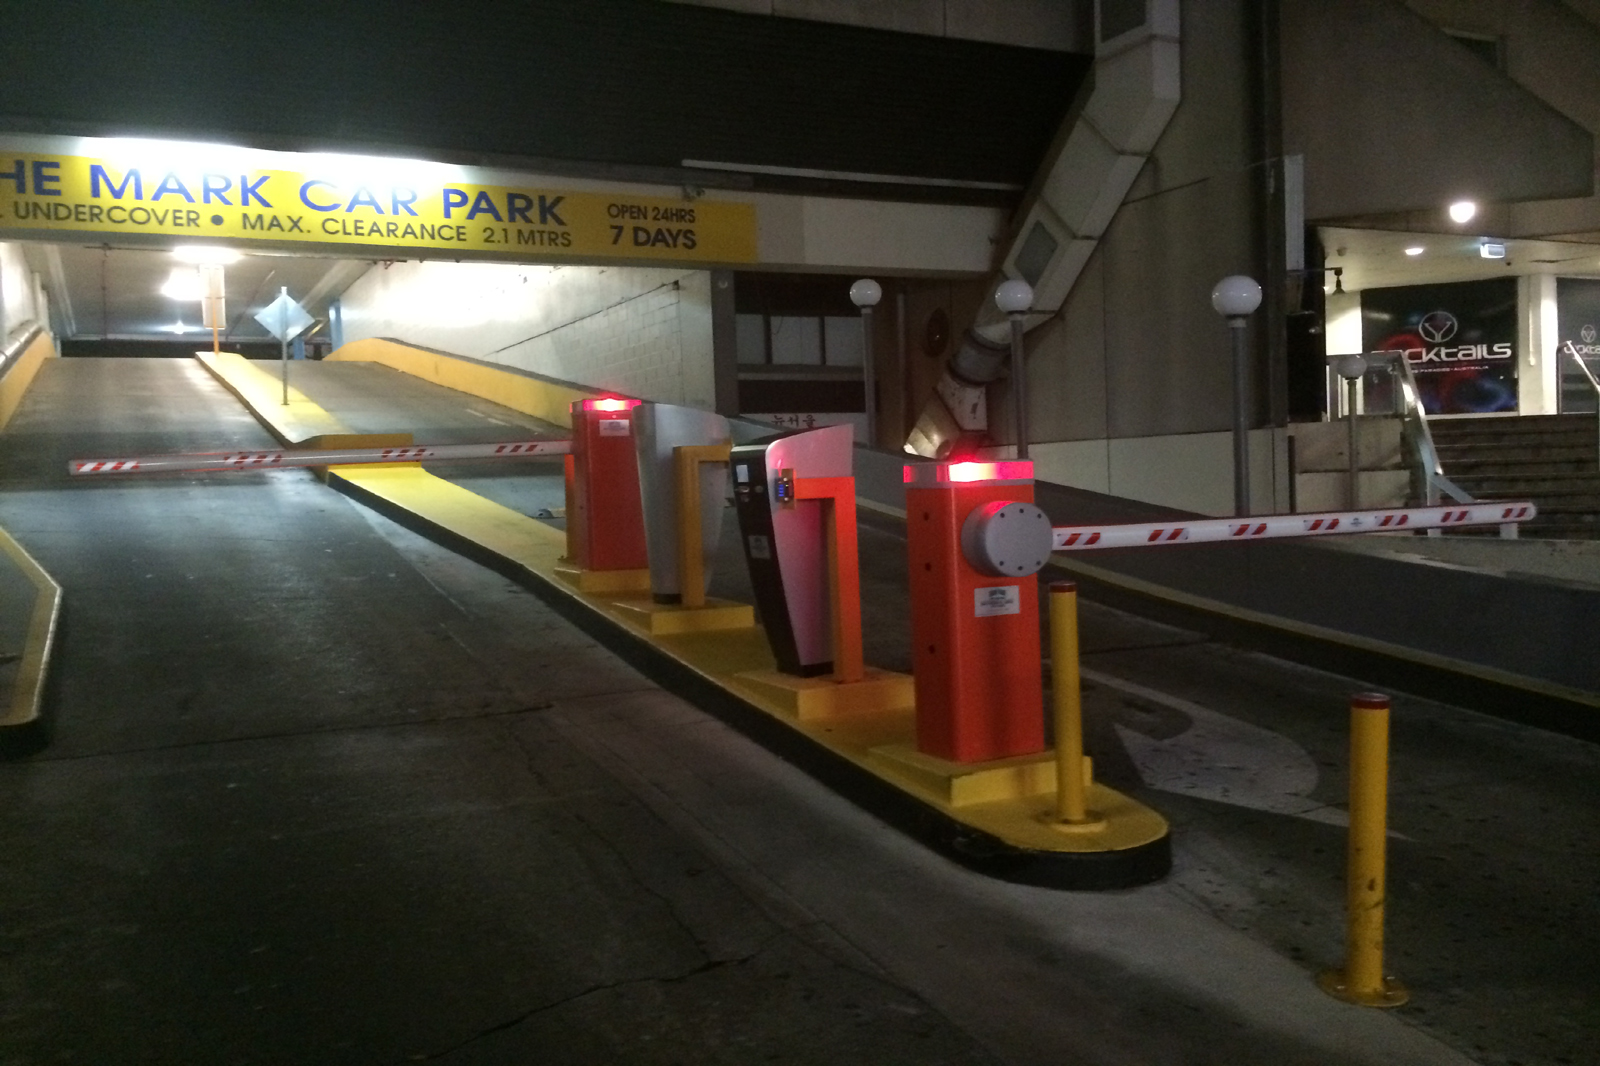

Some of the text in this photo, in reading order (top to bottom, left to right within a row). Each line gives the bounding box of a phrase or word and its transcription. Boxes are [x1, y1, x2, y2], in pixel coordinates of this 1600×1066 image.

[90, 164, 273, 208] MARK
[299, 179, 418, 216] CAR
[443, 188, 568, 226] PARK
[14, 201, 571, 247] UNDERCOVER MAX. CLEARANCE 2.1 MTRS
[607, 203, 696, 224] OPEN 24HRS
[610, 226, 697, 250] 7 DAYS
